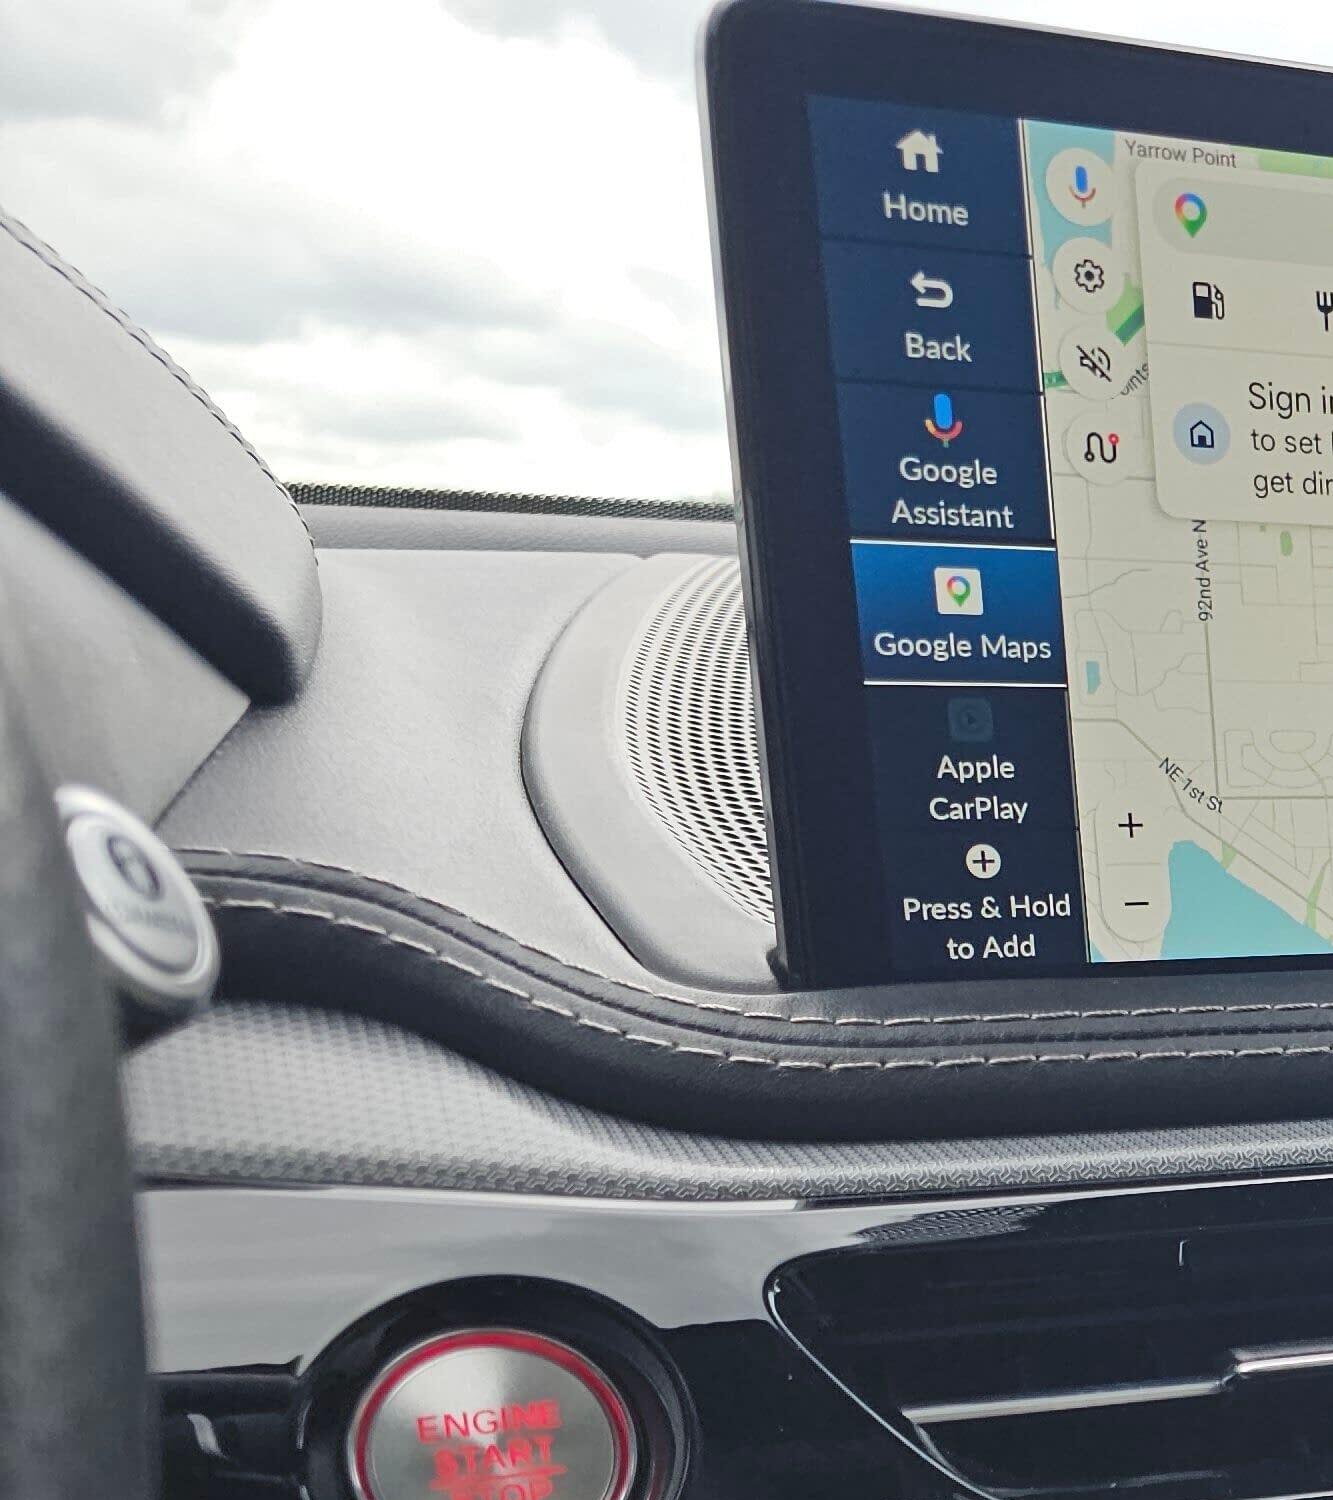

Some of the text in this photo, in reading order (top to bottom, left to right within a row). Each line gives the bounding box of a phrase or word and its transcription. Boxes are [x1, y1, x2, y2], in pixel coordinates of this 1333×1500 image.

[1125, 139, 1237, 168] Yarrow Point
[883, 192, 969, 226] Home
[905, 332, 973, 364] Back
[1248, 381, 1311, 420] Sign
[1250, 428, 1277, 453] to
[1285, 431, 1322, 456] set
[899, 456, 998, 489] Google
[1253, 472, 1294, 501] get
[891, 499, 1014, 529] Assistant
[1192, 519, 1213, 621] 92nd Ave N
[874, 631, 1051, 663] Google Maps
[937, 755, 1015, 785] Apple
[1159, 757, 1222, 814] NE 1st St
[929, 797, 1028, 824] CarPlay
[903, 893, 1071, 922] Press & Hold
[947, 934, 1036, 960] to Add
[416, 1399, 562, 1444] ENGINE
[433, 1436, 555, 1477] START
